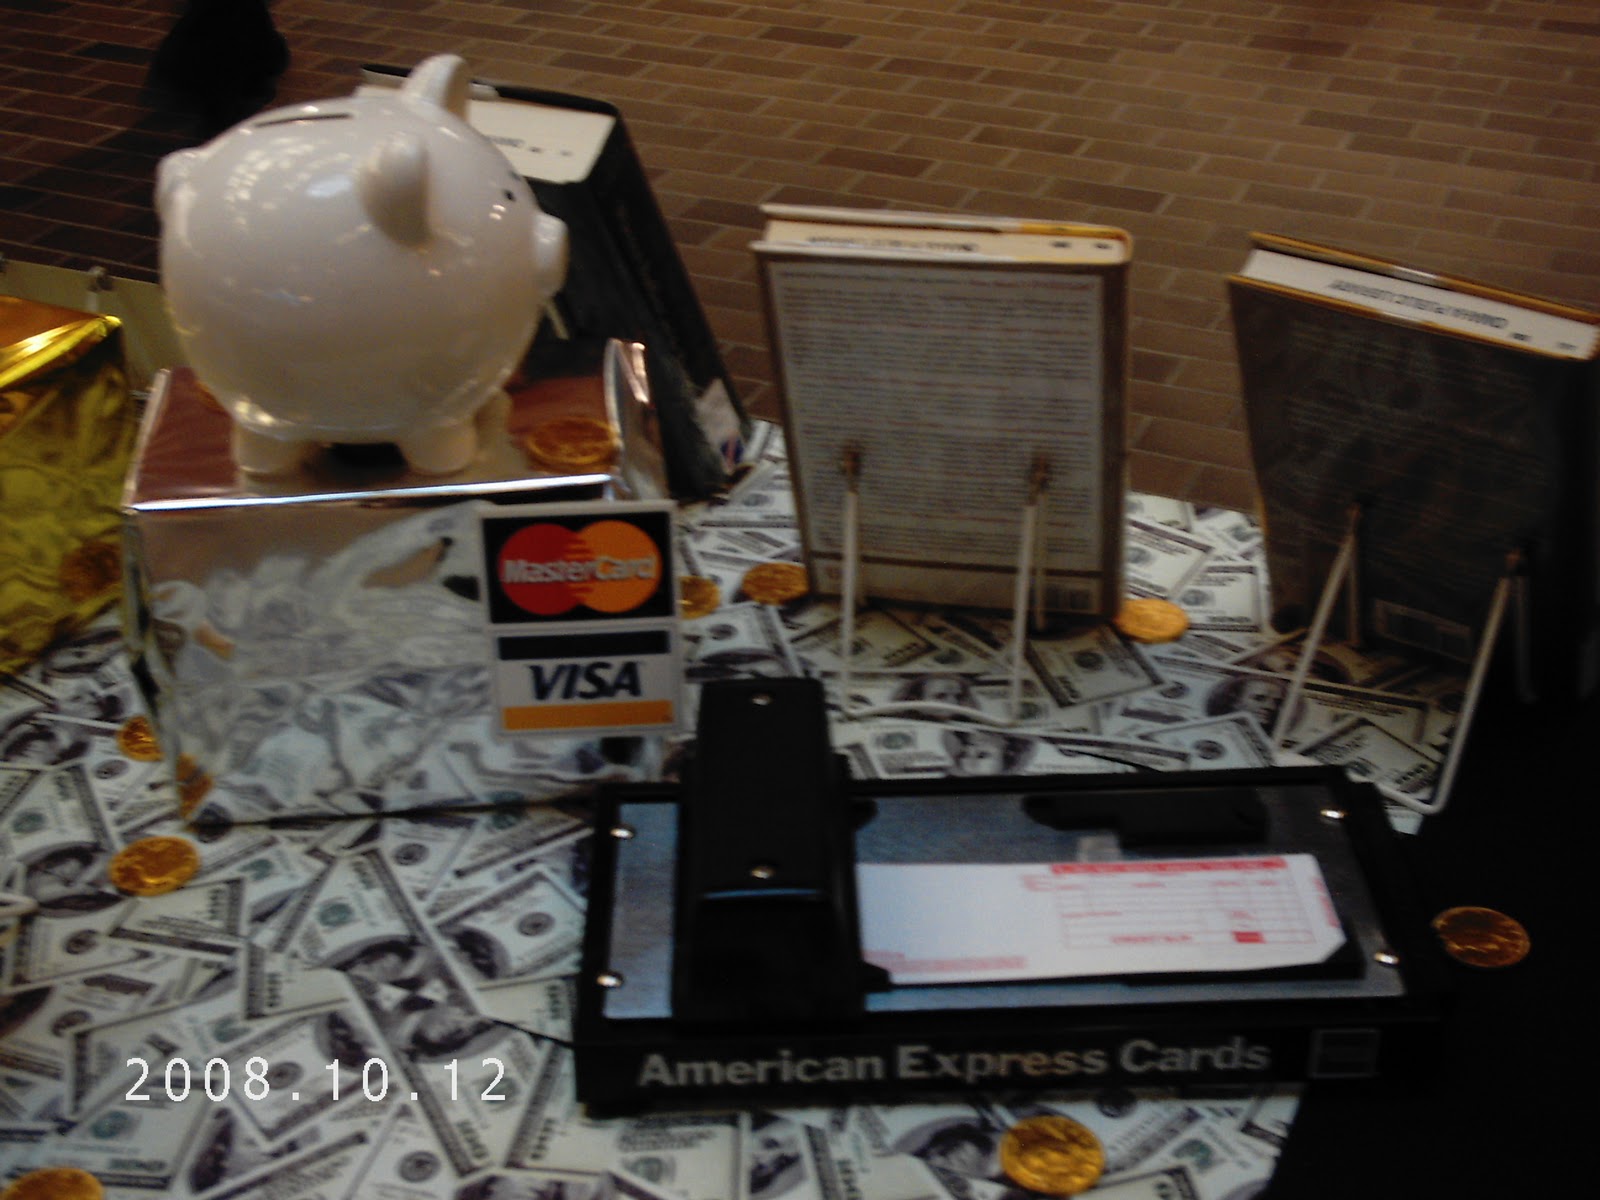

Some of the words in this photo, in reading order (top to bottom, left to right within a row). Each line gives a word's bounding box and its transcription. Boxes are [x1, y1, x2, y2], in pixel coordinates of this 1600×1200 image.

[503, 555, 656, 584] MasterCard
[526, 660, 643, 701] VISA
[637, 1050, 885, 1088] American
[896, 1043, 1109, 1085] Express
[1118, 1036, 1272, 1074] Cards
